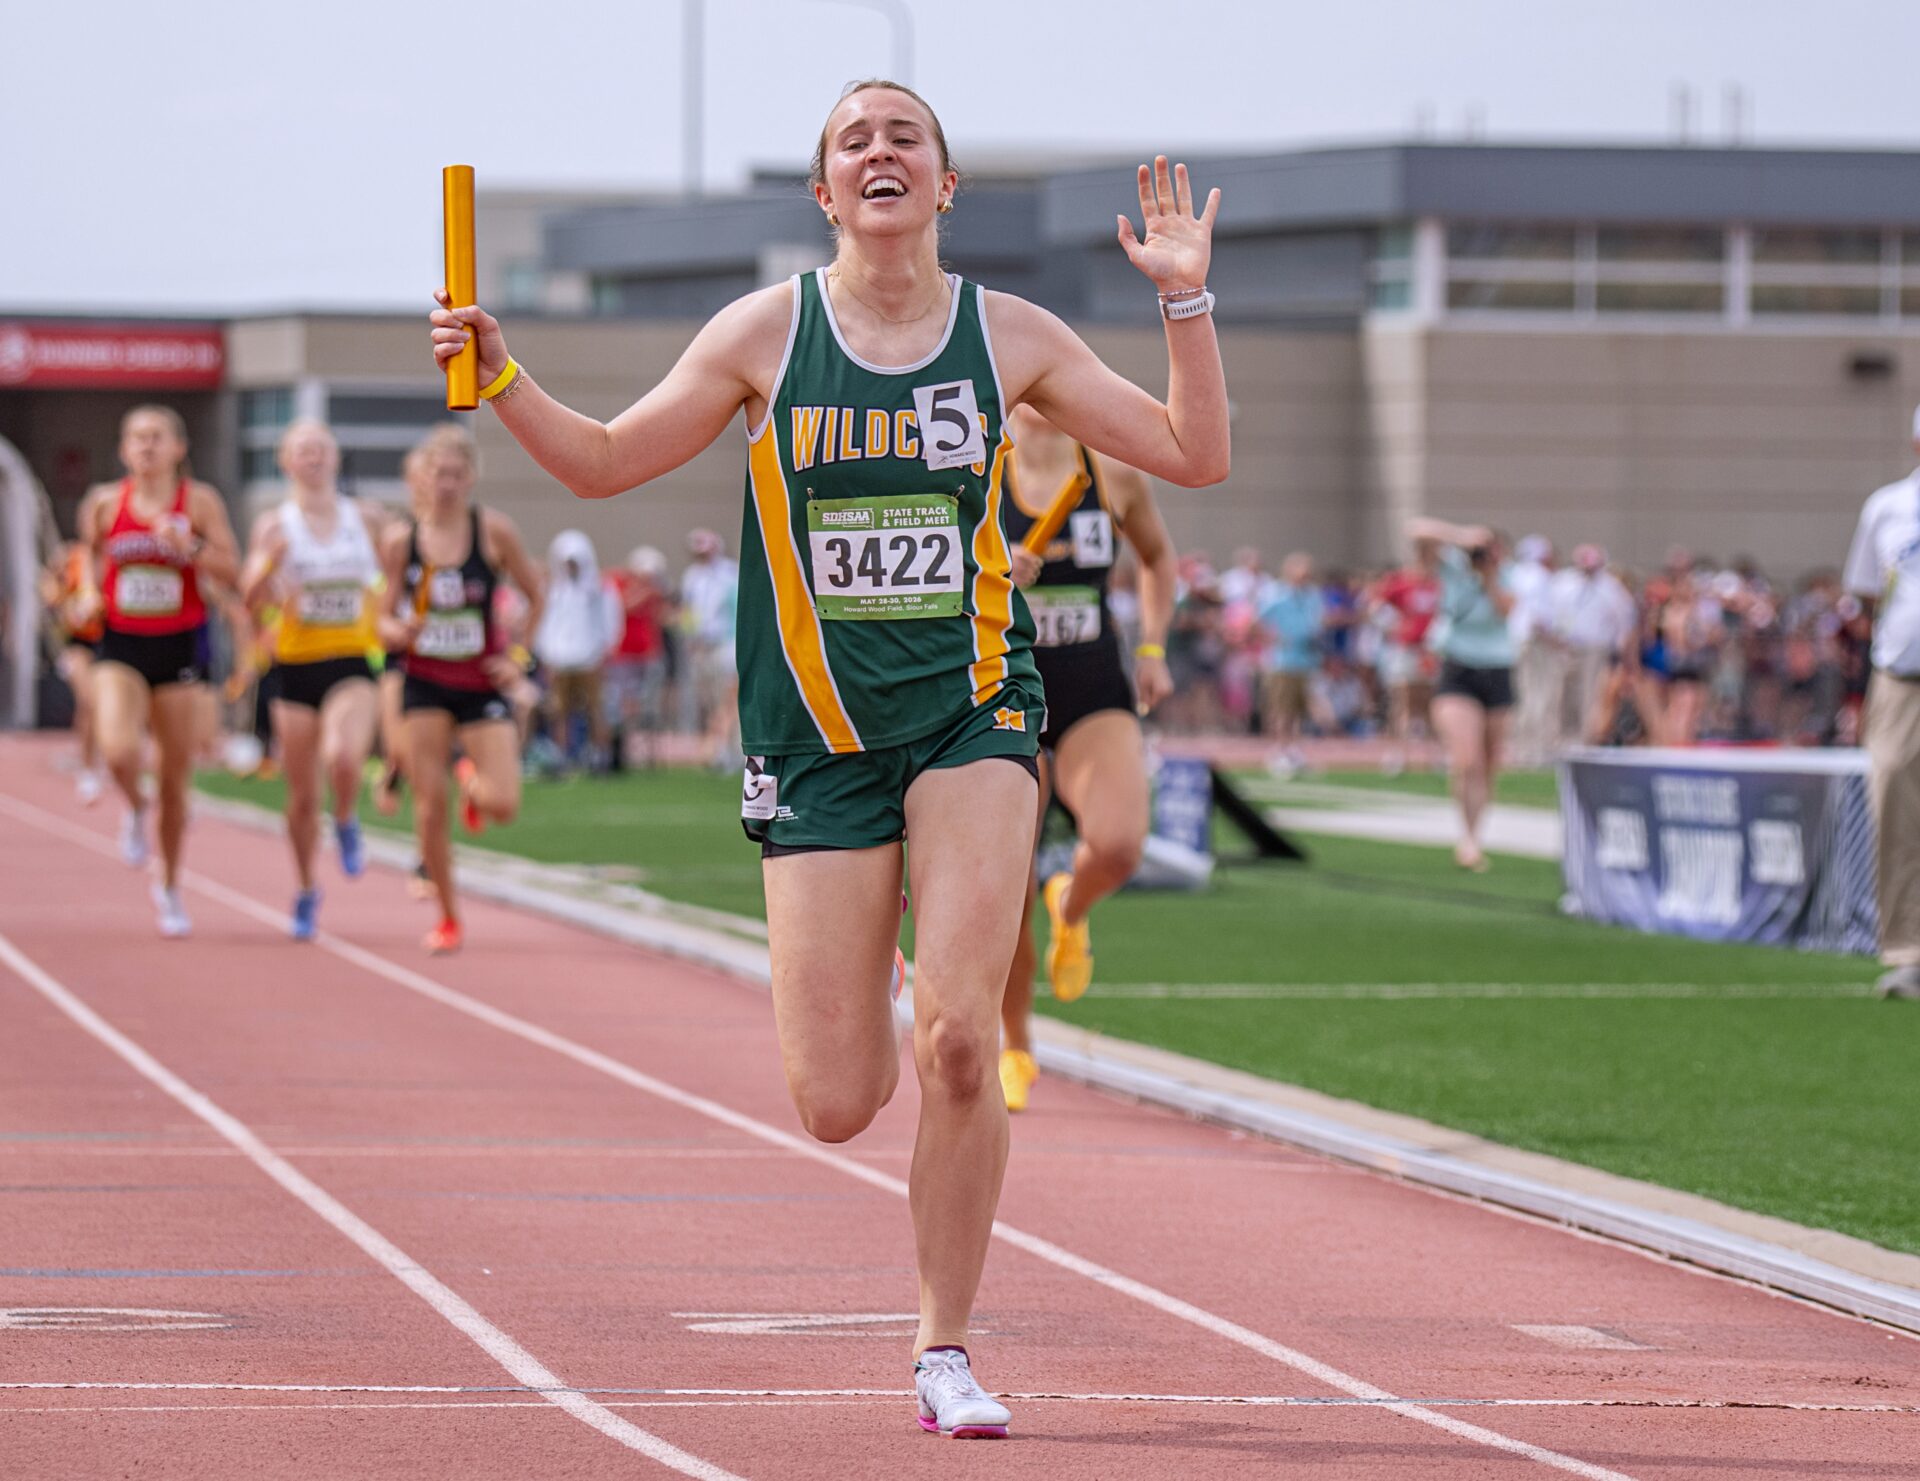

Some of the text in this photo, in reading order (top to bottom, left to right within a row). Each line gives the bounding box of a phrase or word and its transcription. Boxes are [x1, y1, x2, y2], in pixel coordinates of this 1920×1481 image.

[930, 386, 971, 451] 5
[790, 406, 989, 477] WILDC
[822, 511, 870, 522] SDHSAA
[882, 516, 950, 527] & FIELD MEET
[883, 506, 948, 518] STATE TRACK
[1084, 520, 1104, 549] 4
[825, 534, 951, 589] 3422
